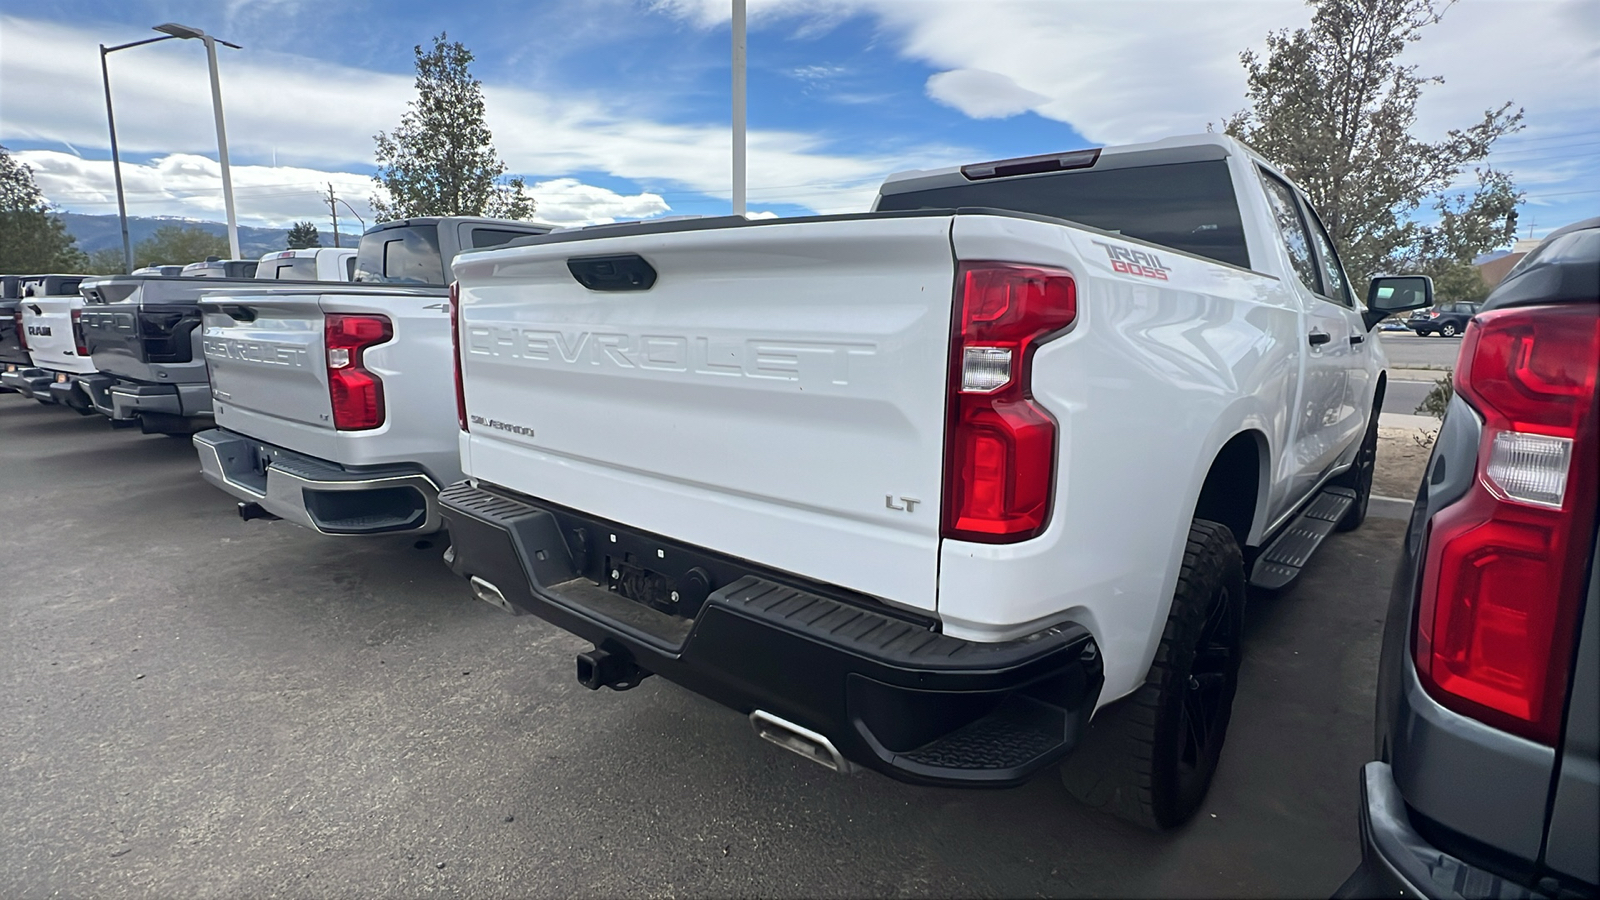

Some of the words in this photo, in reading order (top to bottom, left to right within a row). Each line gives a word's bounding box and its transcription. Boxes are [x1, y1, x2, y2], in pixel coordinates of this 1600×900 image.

[1091, 239, 1172, 272] TRAIL
[1110, 259, 1168, 281] BOSS
[203, 340, 306, 367] CHEVROLET
[468, 326, 878, 386] CHEVROLET
[471, 414, 535, 438] SILVERADO
[885, 494, 921, 513] LT
